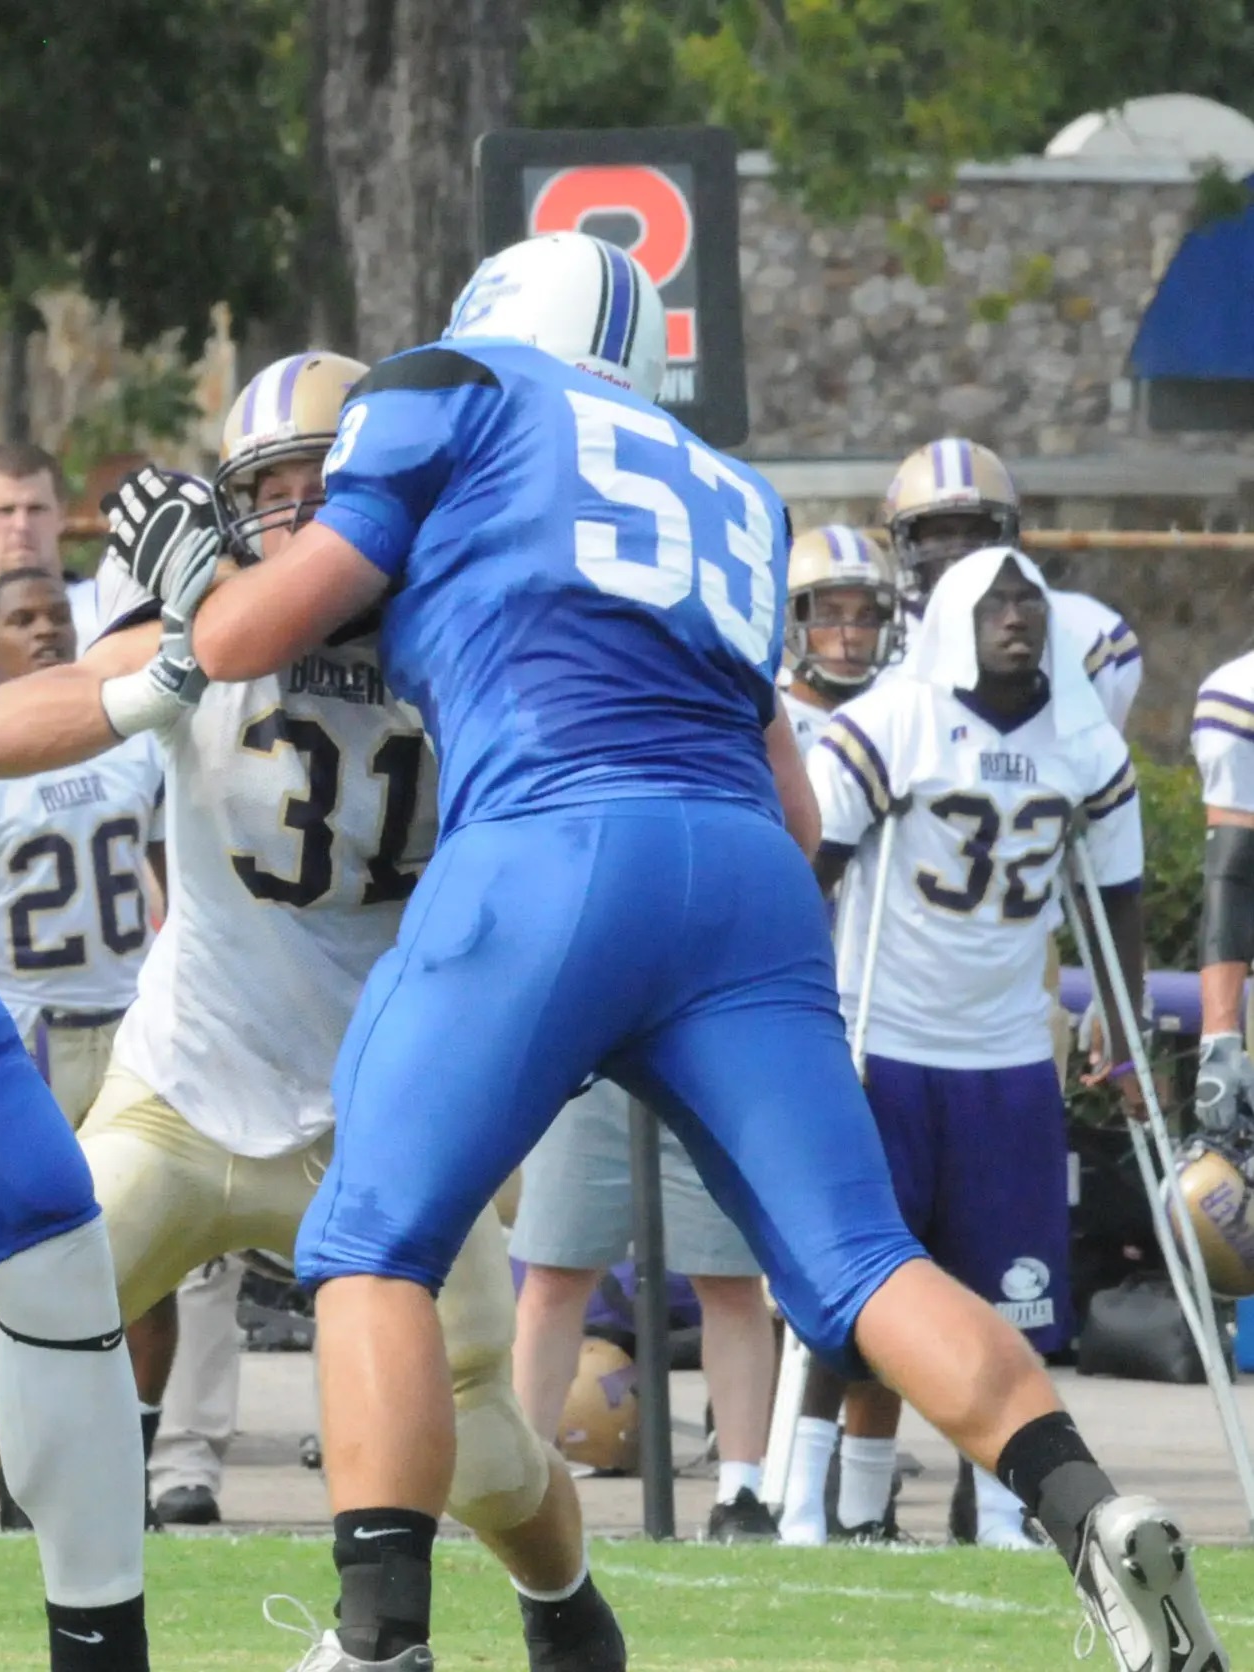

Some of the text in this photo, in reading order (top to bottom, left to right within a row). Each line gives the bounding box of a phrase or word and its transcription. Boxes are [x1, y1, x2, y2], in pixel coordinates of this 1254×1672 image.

[563, 388, 776, 666] 53
[287, 655, 386, 706] BUTLER
[38, 772, 110, 813] BUTLER
[229, 706, 426, 908] 31
[979, 751, 1038, 783] BUTLER
[8, 815, 147, 971] 26
[915, 792, 1072, 920] 32
